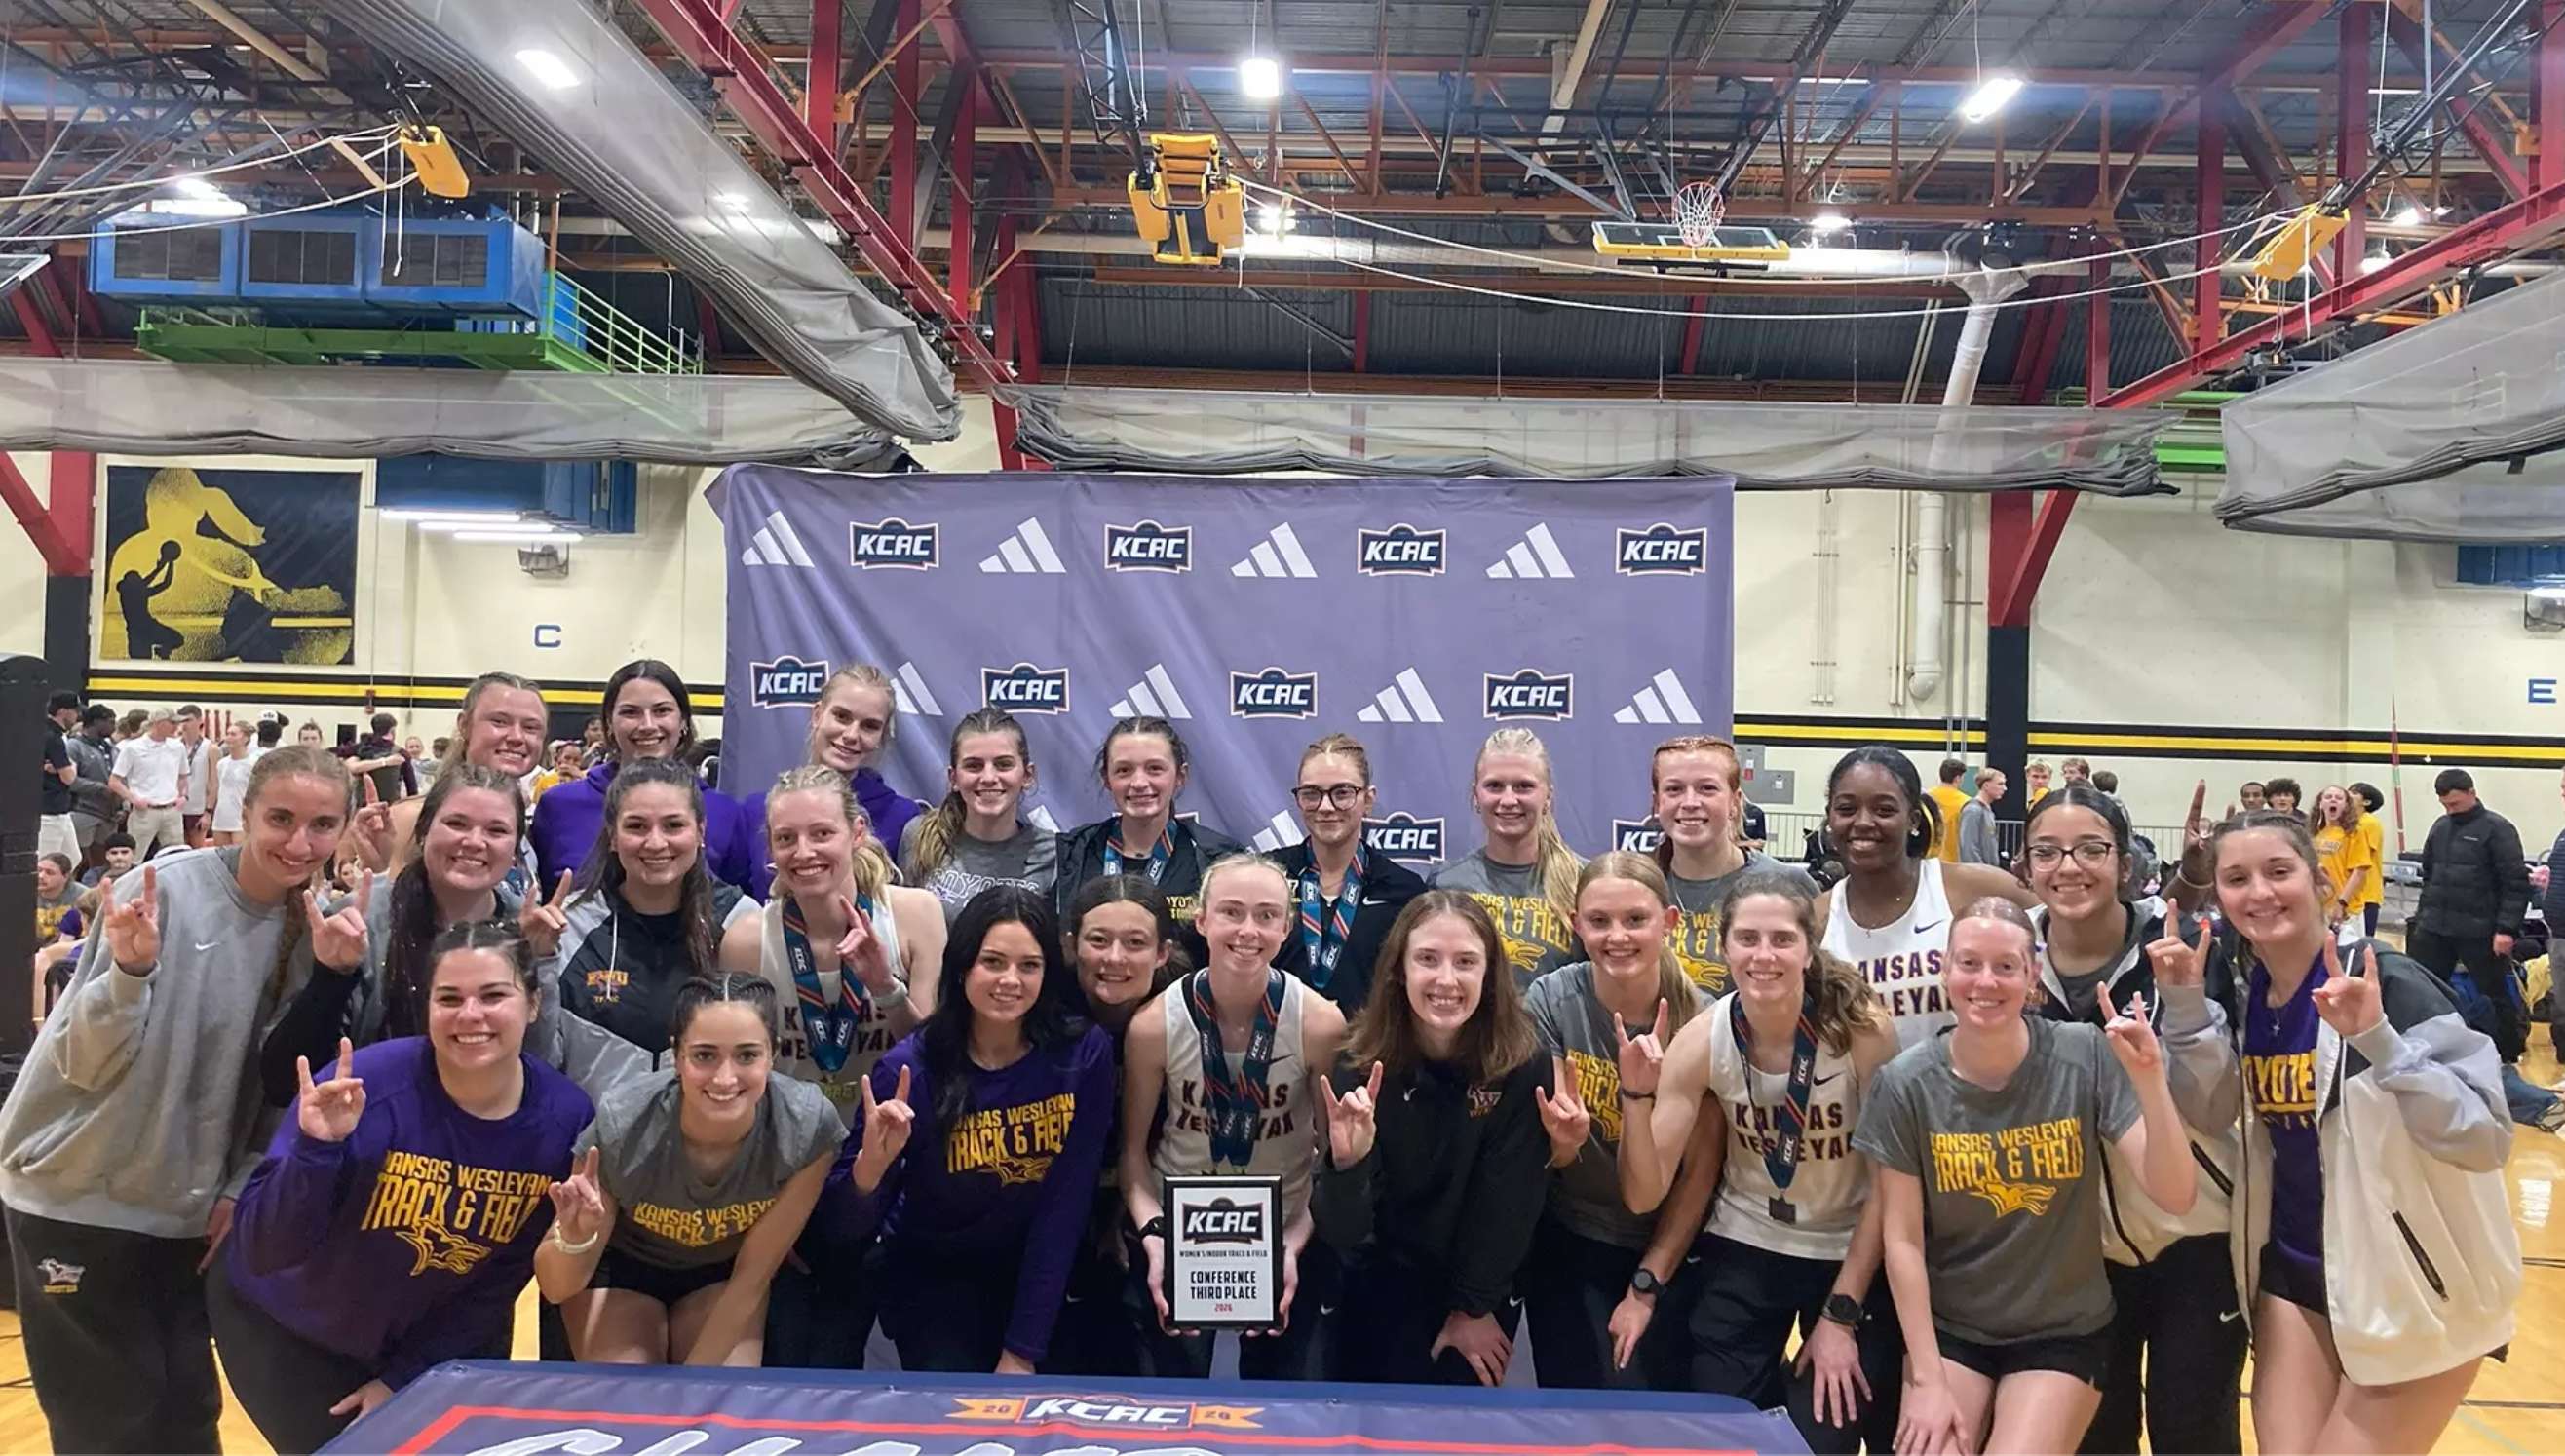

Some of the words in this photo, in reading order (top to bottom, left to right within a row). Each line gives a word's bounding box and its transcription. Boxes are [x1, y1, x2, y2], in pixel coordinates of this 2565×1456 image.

[858, 534, 932, 556] KCAC
[1111, 537, 1186, 559] KCAC
[1364, 539, 1440, 562] KCAC
[1623, 539, 1701, 562] KCAC
[535, 625, 561, 647] C
[759, 672, 823, 694] KCAC
[989, 679, 1062, 701] KCAC
[2528, 679, 2557, 703] E
[1238, 683, 1310, 706] KCAC
[1491, 684, 1566, 707] KCAC
[1367, 828, 1438, 850] KCAC
[1621, 831, 1664, 852] KC
[1858, 949, 1942, 983] ANSAS
[1933, 1150, 2002, 1192] TRACK
[2031, 1135, 2084, 1179] FIELD
[634, 1202, 703, 1227] KANSAS
[1186, 1211, 1259, 1233] KCAC
[1190, 1270, 1257, 1284] CONFERENCE
[1191, 1286, 1222, 1300] THIRD
[1225, 1286, 1257, 1299] PLACE
[1027, 1399, 1187, 1423] KCAC
